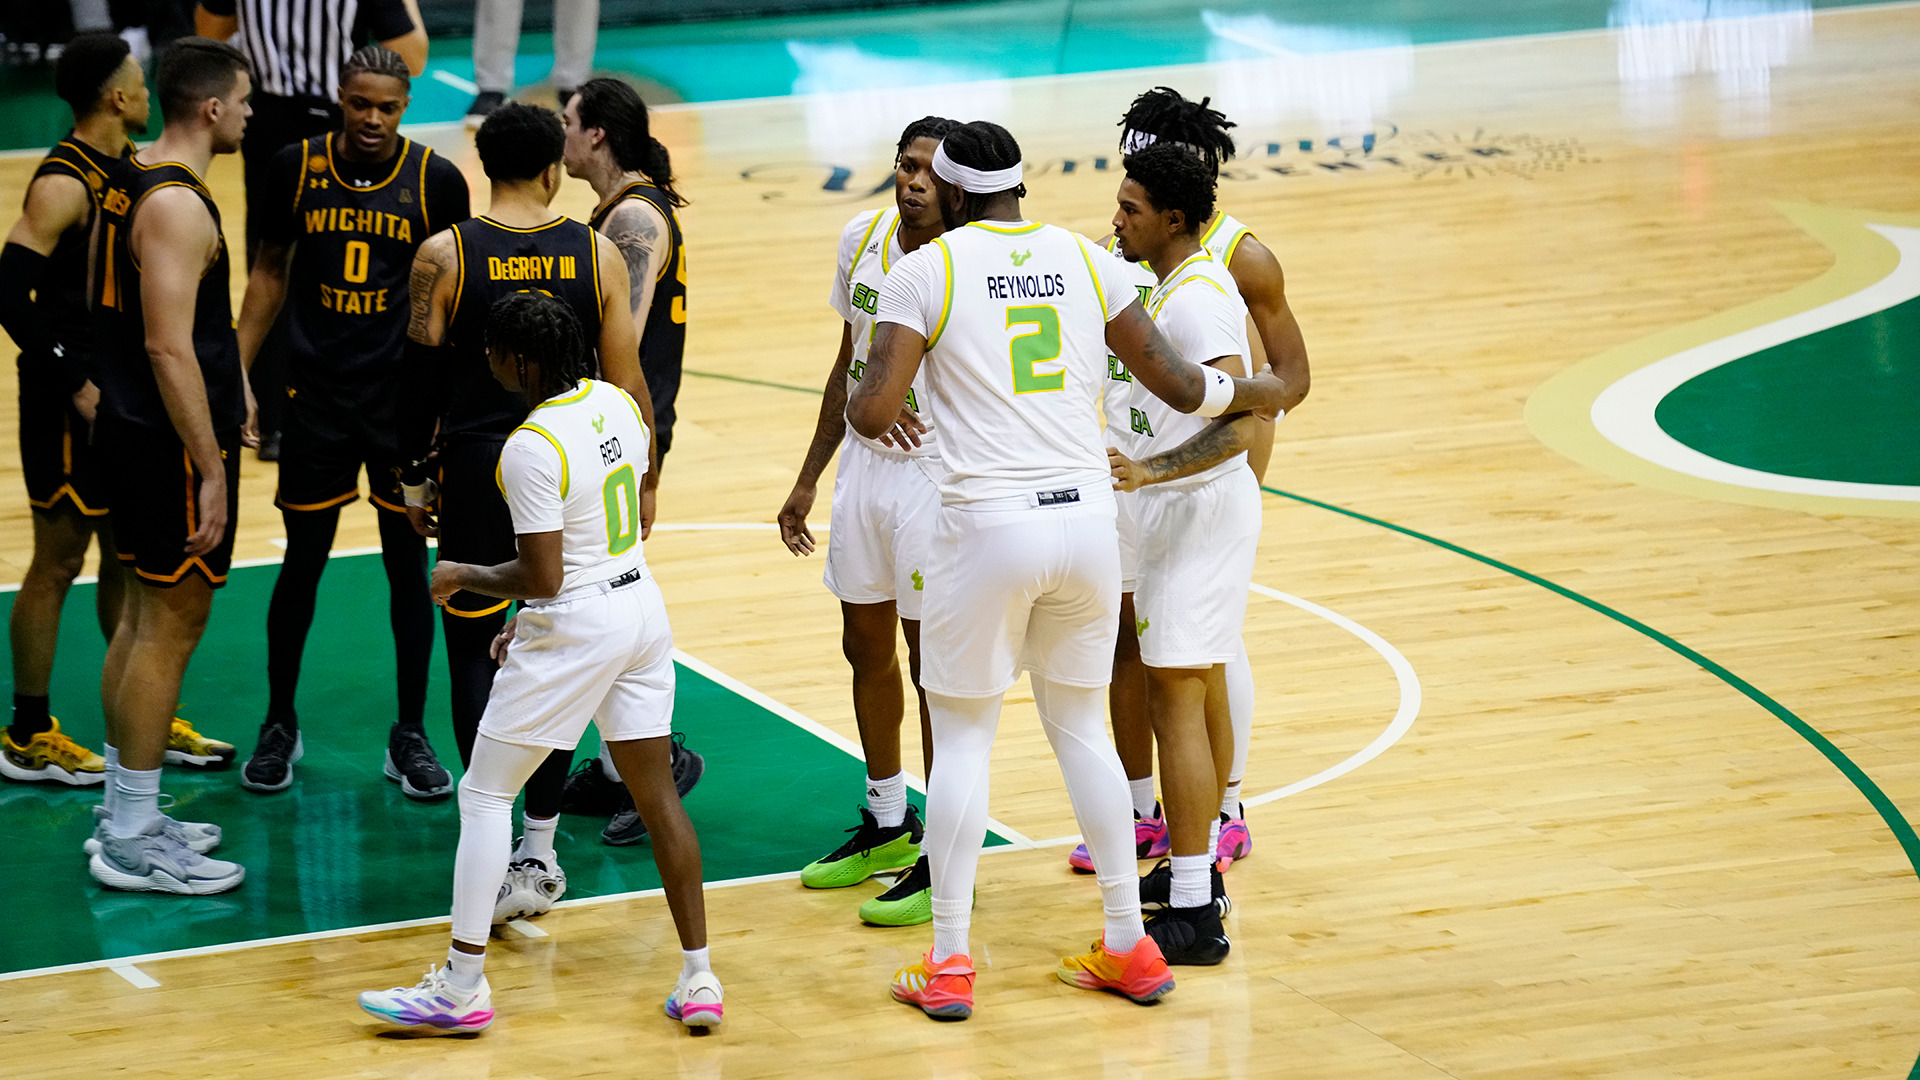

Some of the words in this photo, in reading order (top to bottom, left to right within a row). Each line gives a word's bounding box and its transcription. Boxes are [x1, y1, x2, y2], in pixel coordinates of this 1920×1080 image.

[305, 207, 412, 243] WICHITA
[343, 240, 370, 284] 0
[488, 256, 554, 280] DeGRAY
[559, 256, 576, 279] III
[320, 283, 388, 314] STATE
[987, 273, 1065, 299] REYNOLDS
[1006, 304, 1066, 394] 2
[599, 436, 622, 467] REID
[603, 463, 638, 556] 0
